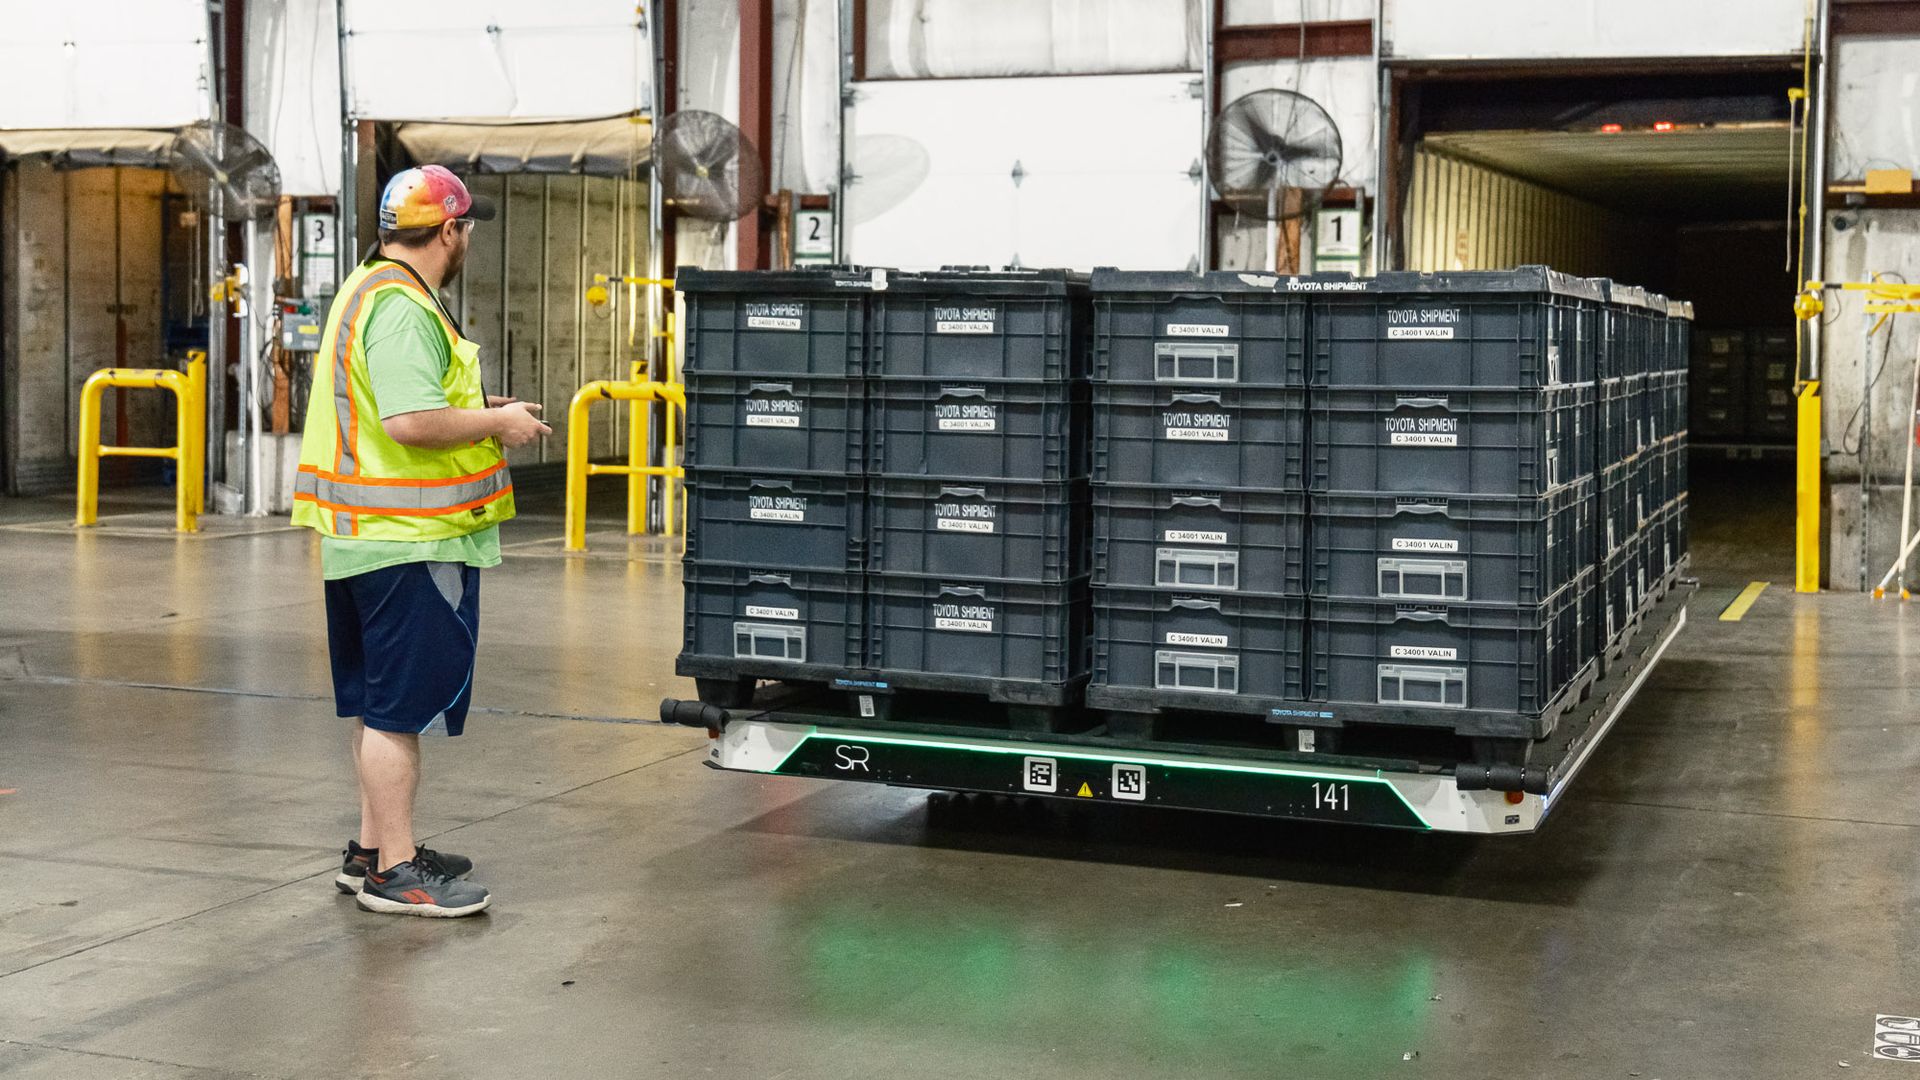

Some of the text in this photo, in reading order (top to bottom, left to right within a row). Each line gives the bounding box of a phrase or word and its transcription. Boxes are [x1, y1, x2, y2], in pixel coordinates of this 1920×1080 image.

[314, 219, 325, 242] 3
[809, 216, 820, 240] 2
[1331, 215, 1342, 242] 1
[1287, 282, 1367, 291] TOYOTA SHIPMENT
[745, 303, 804, 316] TOYOTA SHIPMENT
[934, 307, 996, 321] TOYOTA SHIPMENT
[1387, 309, 1461, 324] TOYOTA SHIPMENT
[1179, 326, 1199, 334] 34001
[745, 399, 804, 413] TOYOTA SHIPMENT
[934, 405, 997, 418] TOYOTA SHIPMENT
[1162, 412, 1230, 427] TOYOTA SHIPMENT
[1384, 417, 1458, 432] TOYOTA SHIPMENT
[1179, 430, 1199, 438] 34001
[1405, 435, 1426, 443] 34001
[749, 496, 808, 510] TOYOTA SHIPMENT
[779, 512, 800, 520] VALIN
[934, 503, 997, 518] TOYOTA SHIPMENT
[968, 522, 989, 530] VALIN
[1178, 532, 1198, 540] 34001
[1200, 533, 1223, 541] VALIN
[1396, 540, 1402, 548] C
[775, 609, 794, 617] VALIN
[932, 603, 995, 620] TOYOTA SHIPMENT
[947, 620, 966, 628] 34001
[967, 621, 988, 629] VALIN
[1178, 635, 1198, 643] 34001
[1200, 636, 1223, 644] VALIN
[1403, 648, 1425, 656] 34001
[1427, 649, 1452, 657] VALIN
[1271, 708, 1293, 716] TOYOTA
[1292, 709, 1318, 718] SHIPMENT
[834, 744, 869, 772] SR
[1311, 782, 1349, 811] 141
